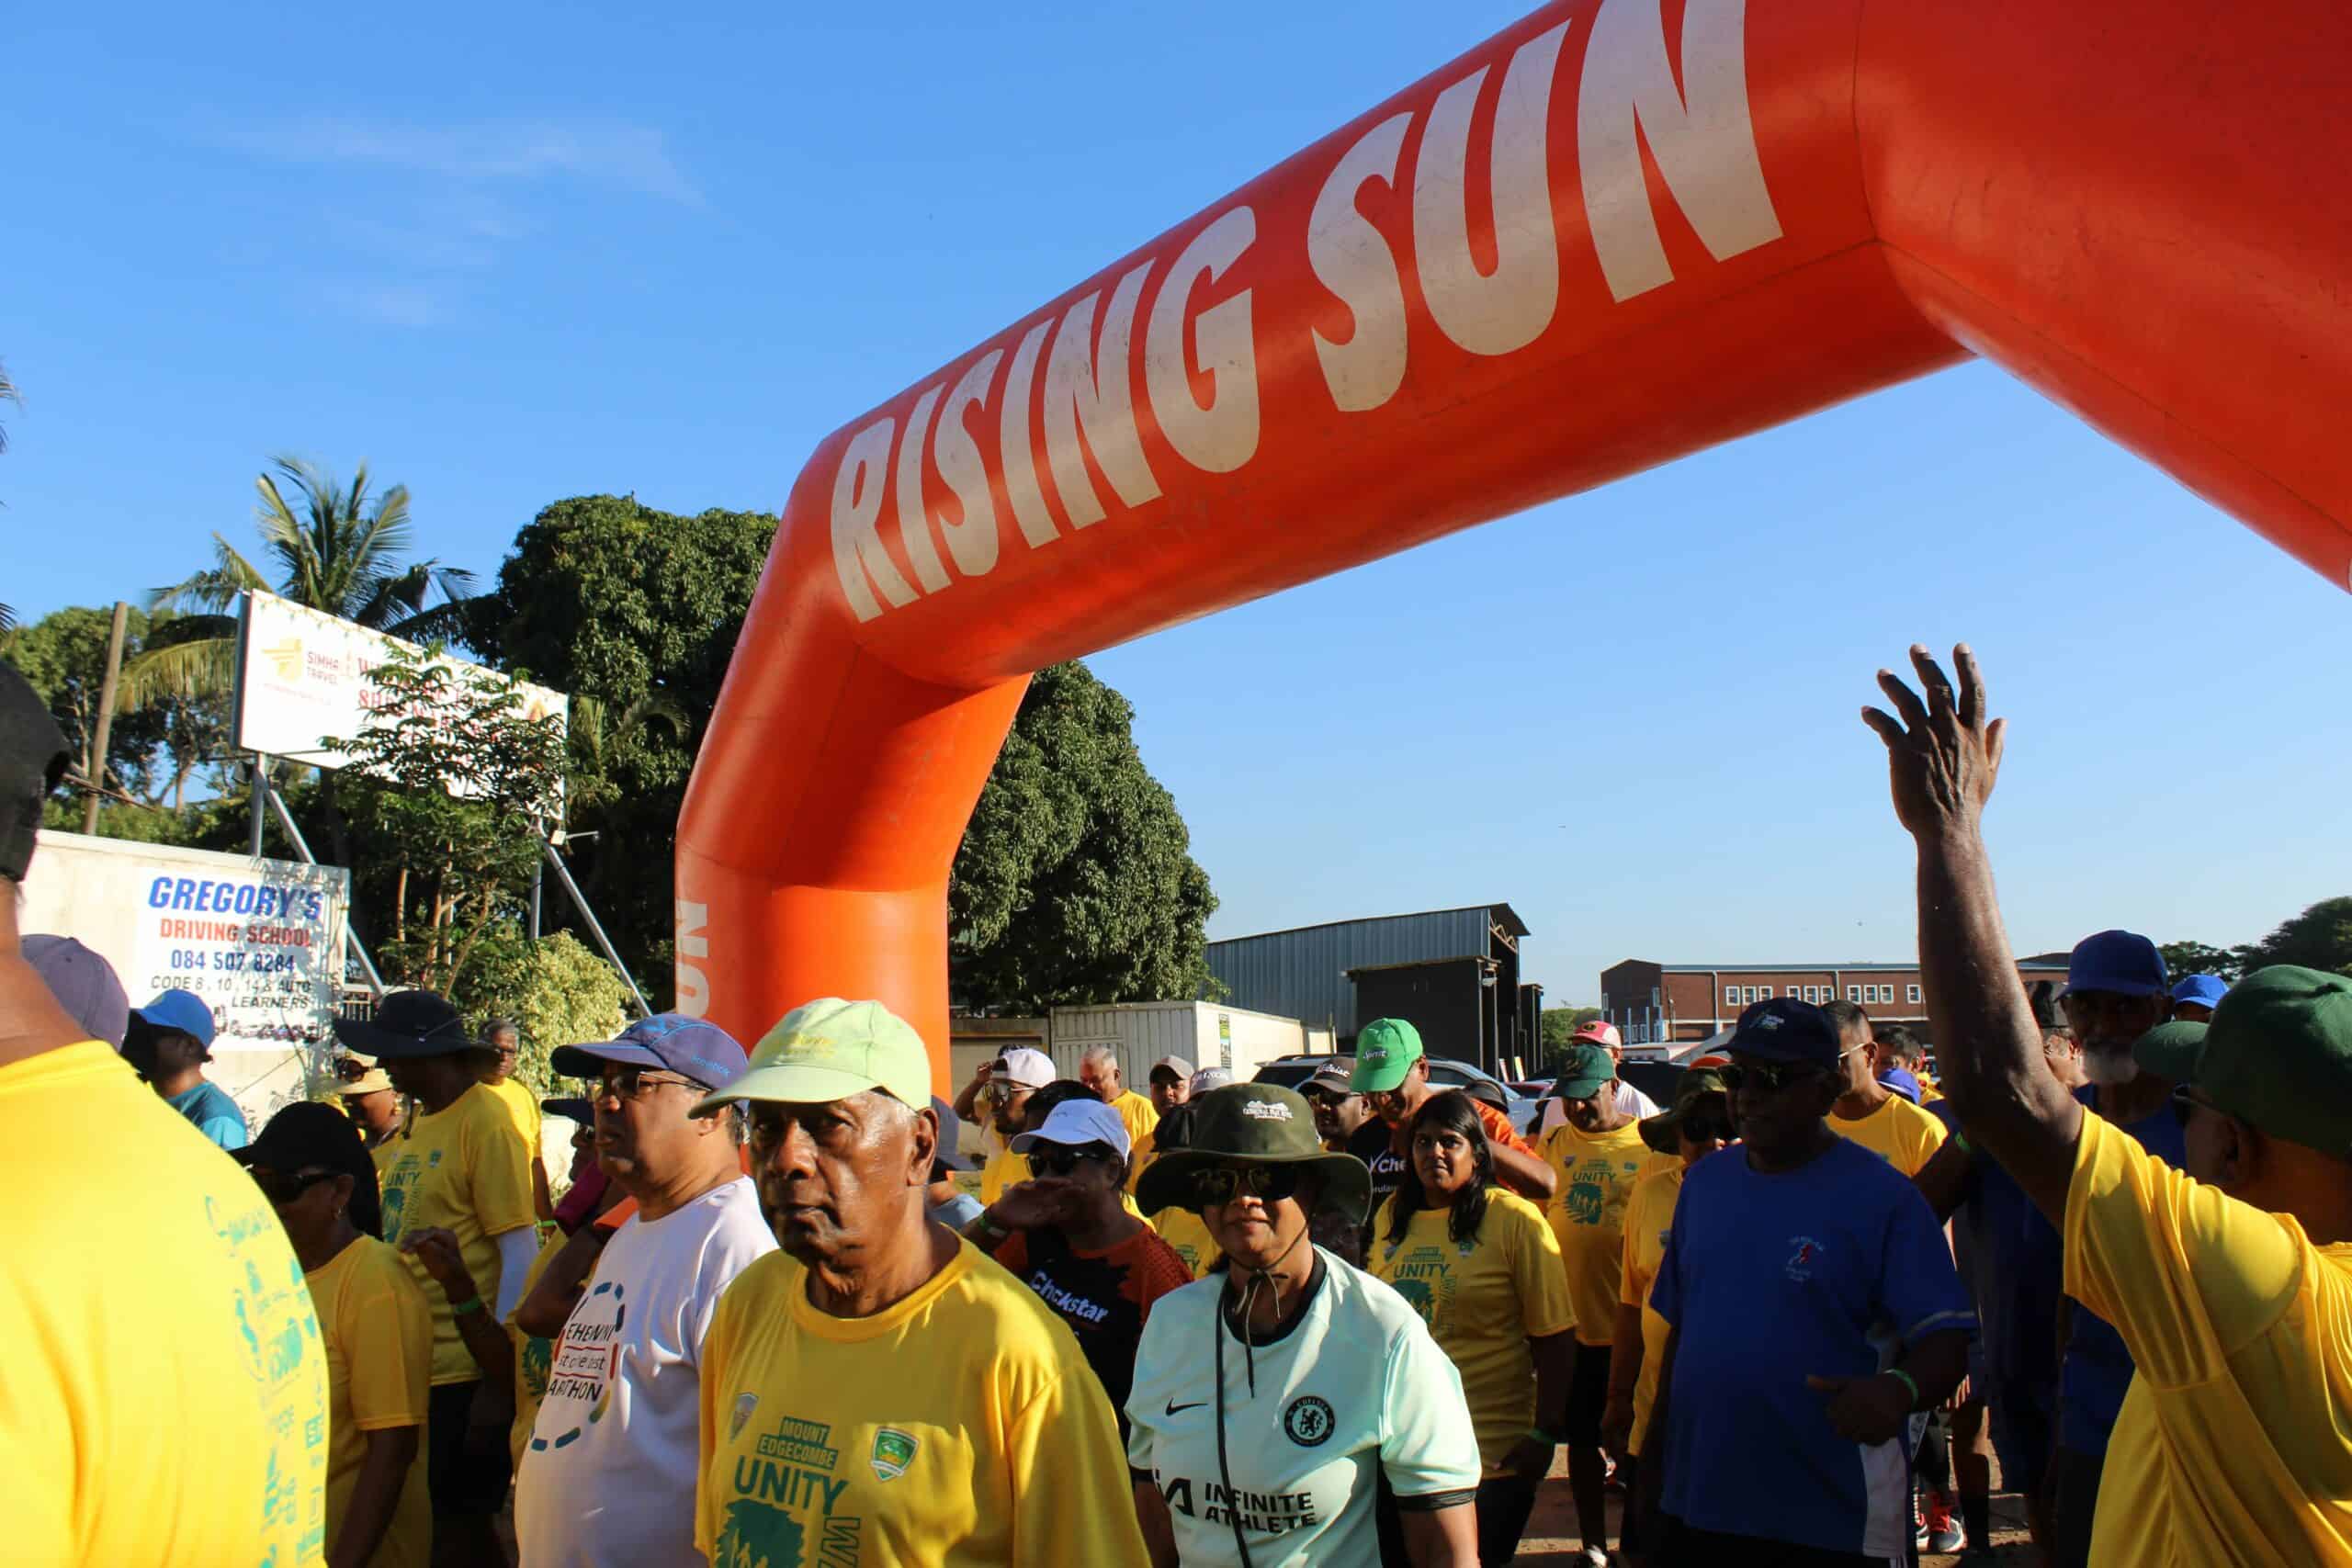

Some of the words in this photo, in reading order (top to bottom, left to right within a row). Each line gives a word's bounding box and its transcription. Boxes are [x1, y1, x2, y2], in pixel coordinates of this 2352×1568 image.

[831, 206, 1261, 624] RISING
[1307, 0, 1783, 412] SUN
[148, 877, 323, 919] GREGORY'S
[160, 919, 239, 942] DRIVING
[246, 924, 311, 947] SCHOOL
[172, 950, 207, 970] 084
[214, 952, 246, 971] 507
[254, 953, 295, 973] 8284
[151, 976, 191, 989] CODE
[278, 979, 311, 994] AUTO
[232, 996, 310, 1010] LEARNERS
[1572, 1171, 1617, 1183] UNITY
[1394, 1263, 1451, 1279] UNITY
[782, 1419, 828, 1444] MOUNT
[759, 1436, 835, 1468] EDGECOMBE
[734, 1454, 850, 1516] UNITY
[1205, 1483, 1314, 1514] INFINITE
[1205, 1506, 1317, 1534] ATHLETE
